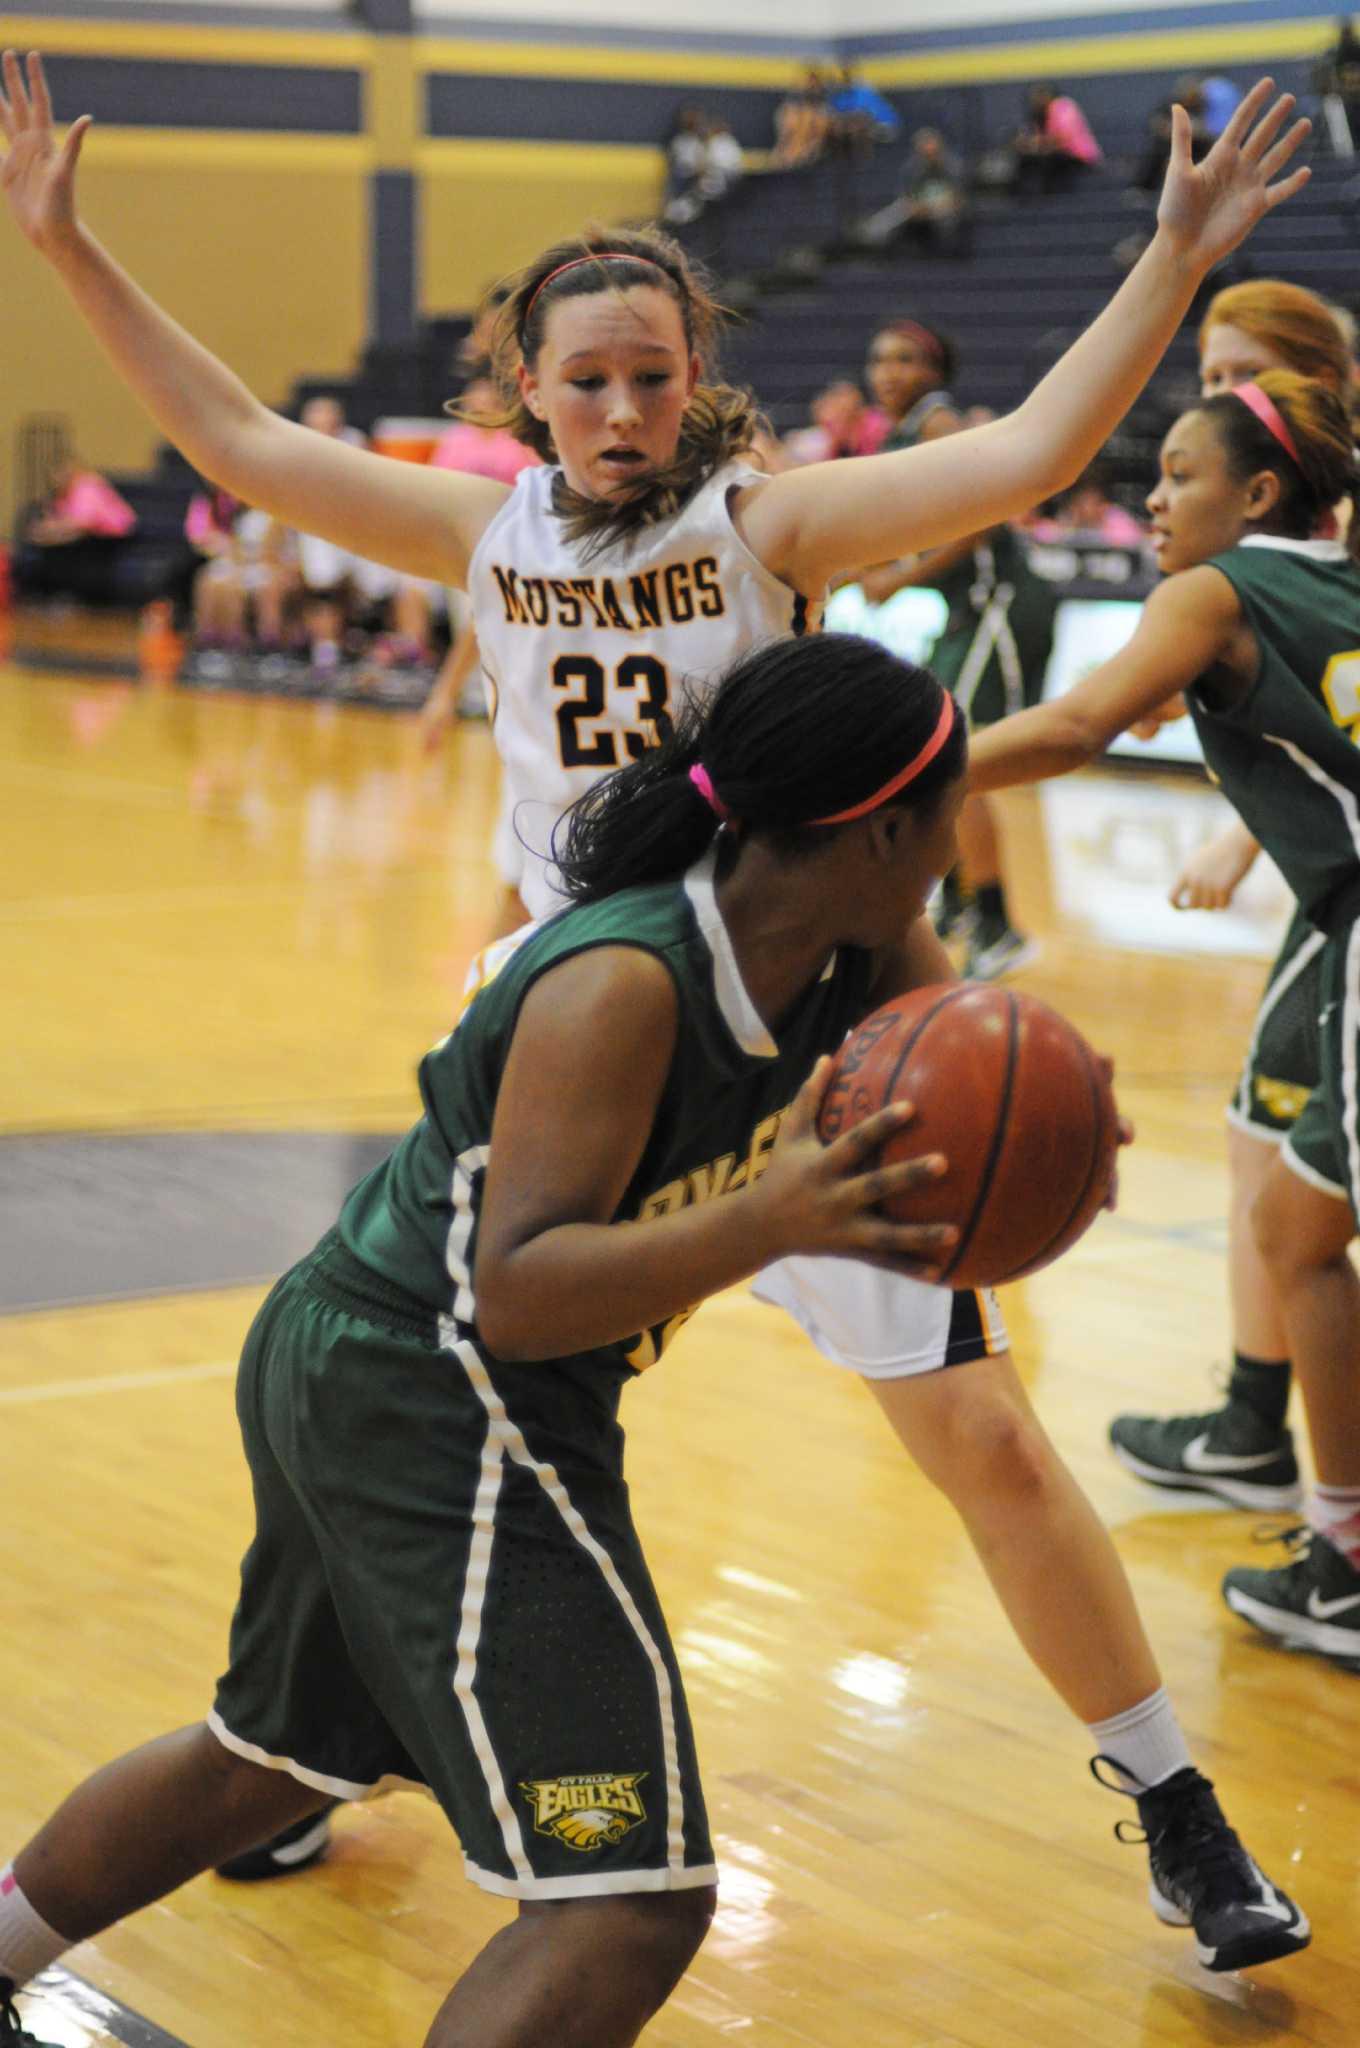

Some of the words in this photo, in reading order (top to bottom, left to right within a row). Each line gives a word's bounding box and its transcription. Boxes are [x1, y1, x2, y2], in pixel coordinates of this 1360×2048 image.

[491, 555, 725, 632] MUSTANGS
[551, 653, 676, 770] 23
[532, 1776, 642, 1825] EAGLES
